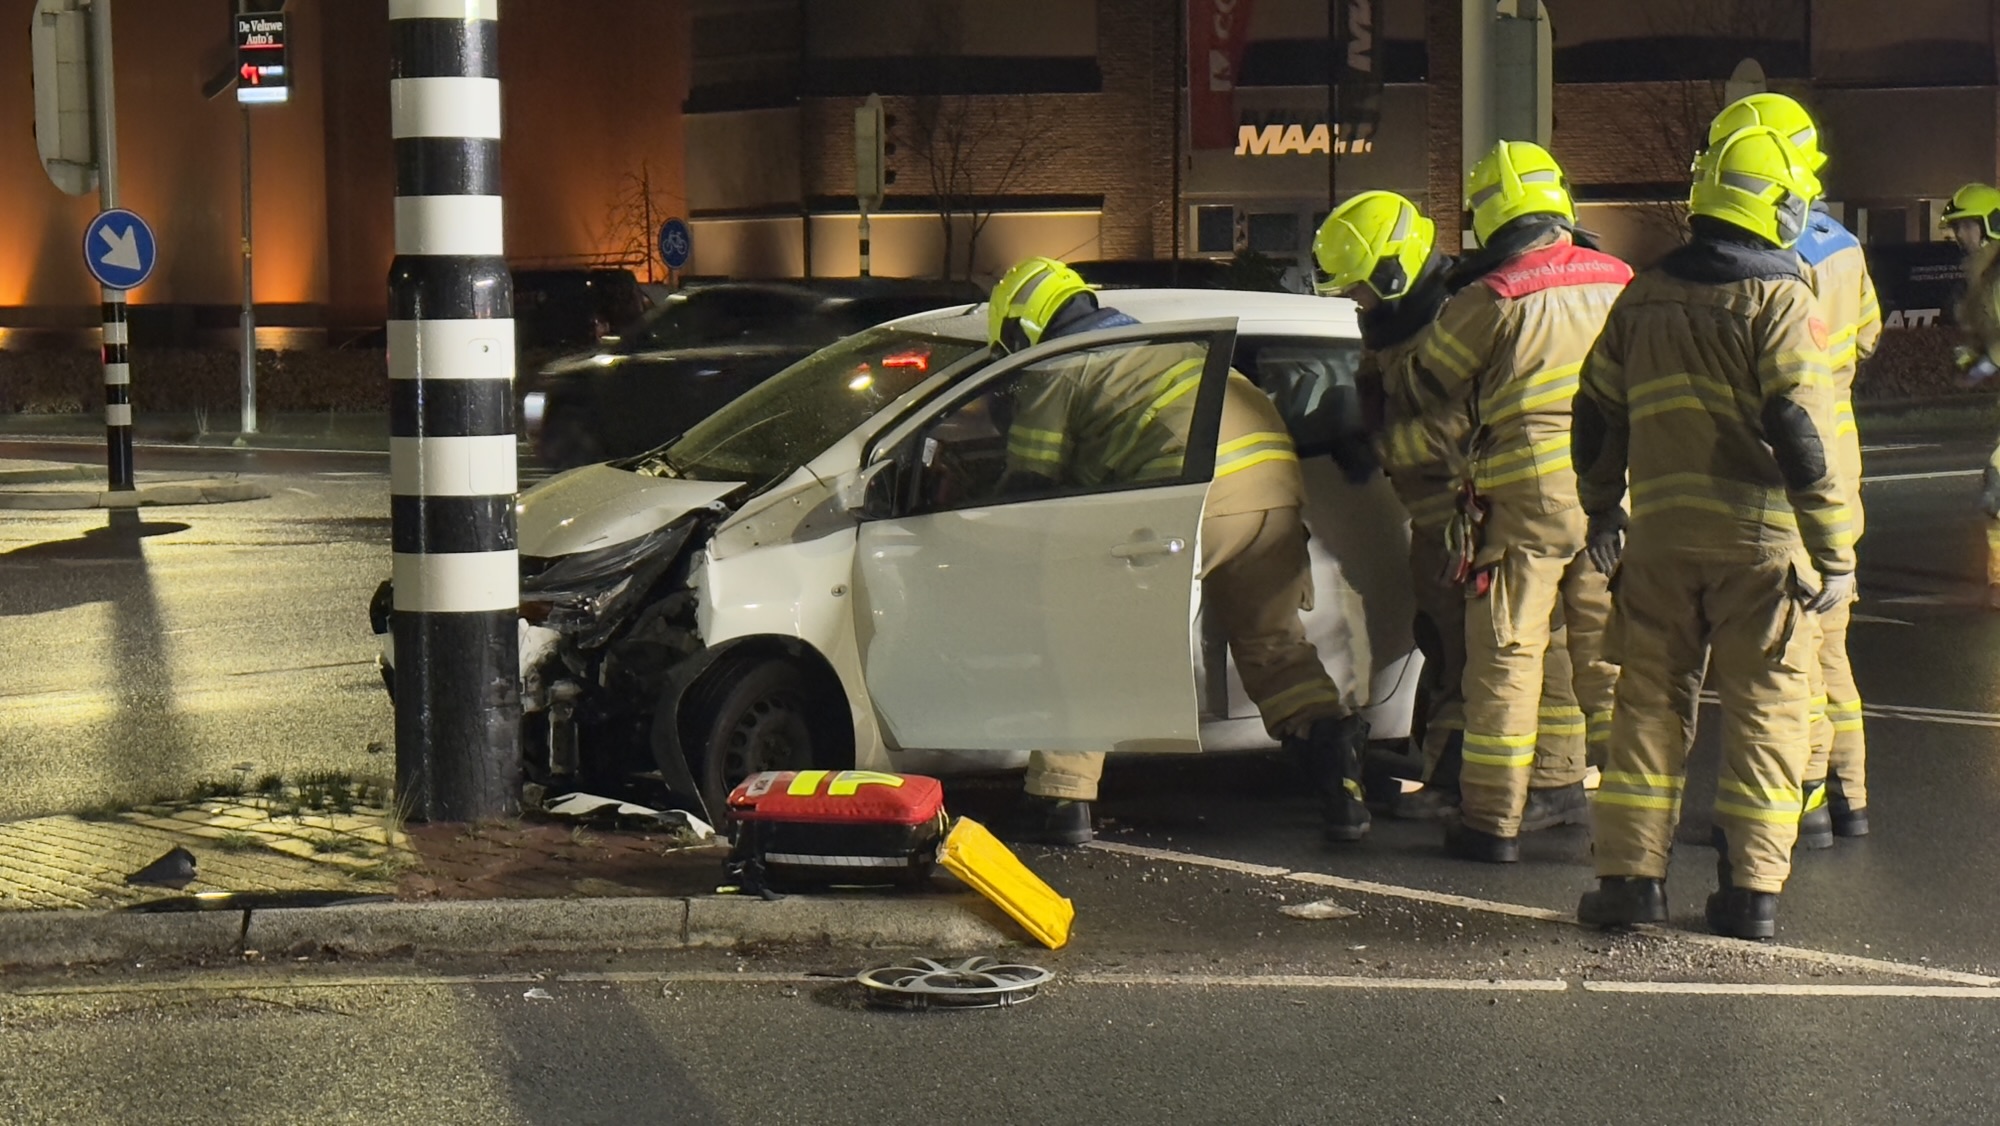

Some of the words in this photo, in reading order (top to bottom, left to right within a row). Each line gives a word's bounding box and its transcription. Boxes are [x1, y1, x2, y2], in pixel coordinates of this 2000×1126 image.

[239, 21, 250, 32] De
[251, 19, 283, 32] Veluwe
[246, 33, 273, 44] Auto's
